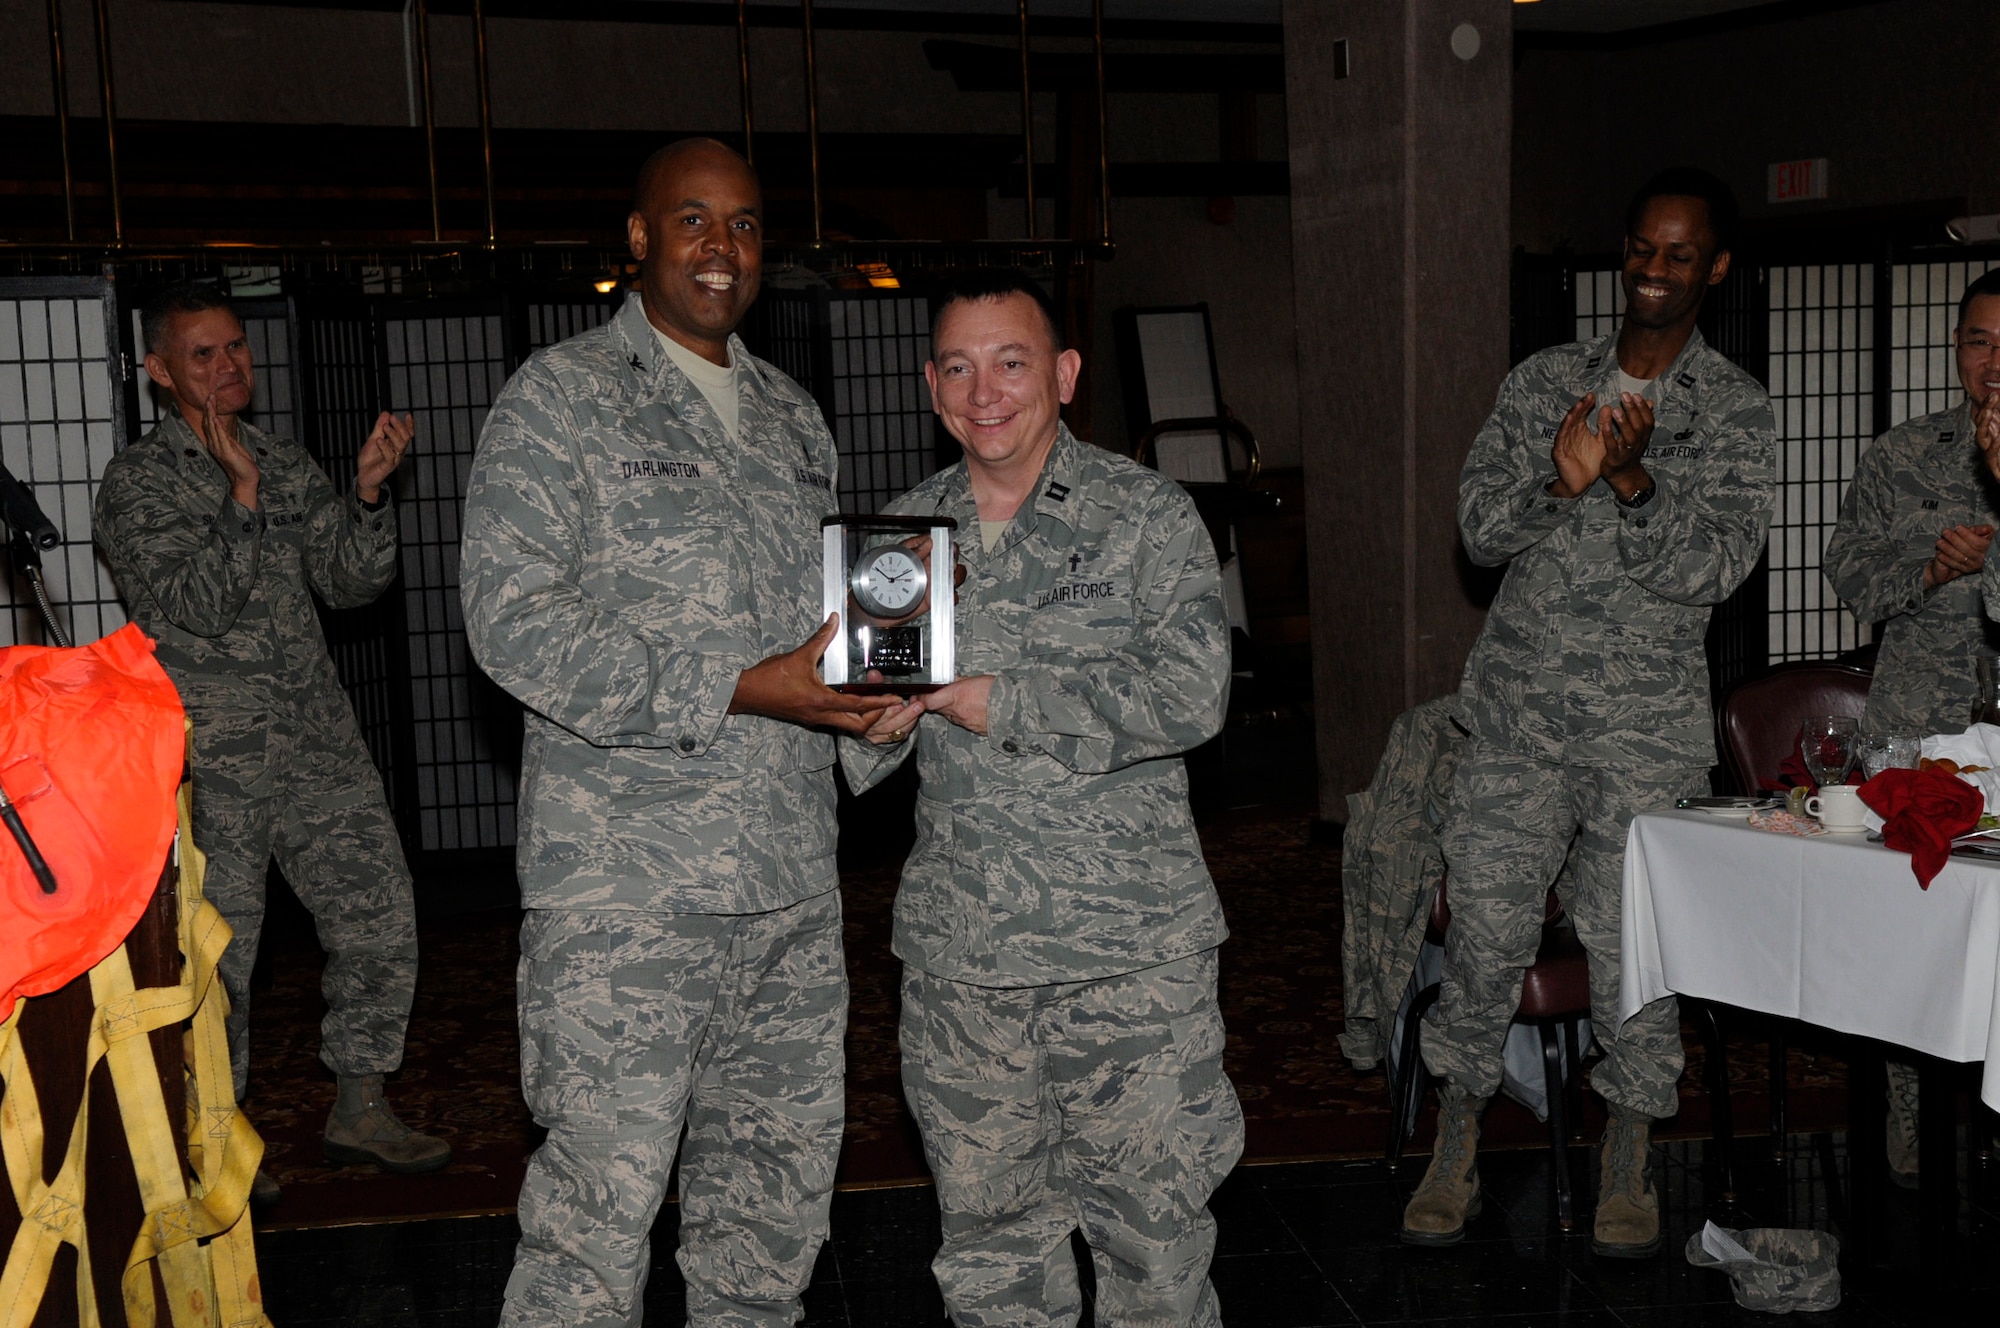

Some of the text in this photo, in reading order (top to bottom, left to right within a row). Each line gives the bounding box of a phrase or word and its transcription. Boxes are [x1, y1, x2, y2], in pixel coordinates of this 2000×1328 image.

[1777, 161, 1812, 198] EXIT
[1660, 447, 1676, 458] AIR
[621, 460, 701, 479] DARLINGTON
[1921, 499, 1938, 510] KIM
[273, 514, 290, 526] U.S.
[1051, 587, 1070, 603] AIR
[1073, 581, 1115, 600] FORCE
